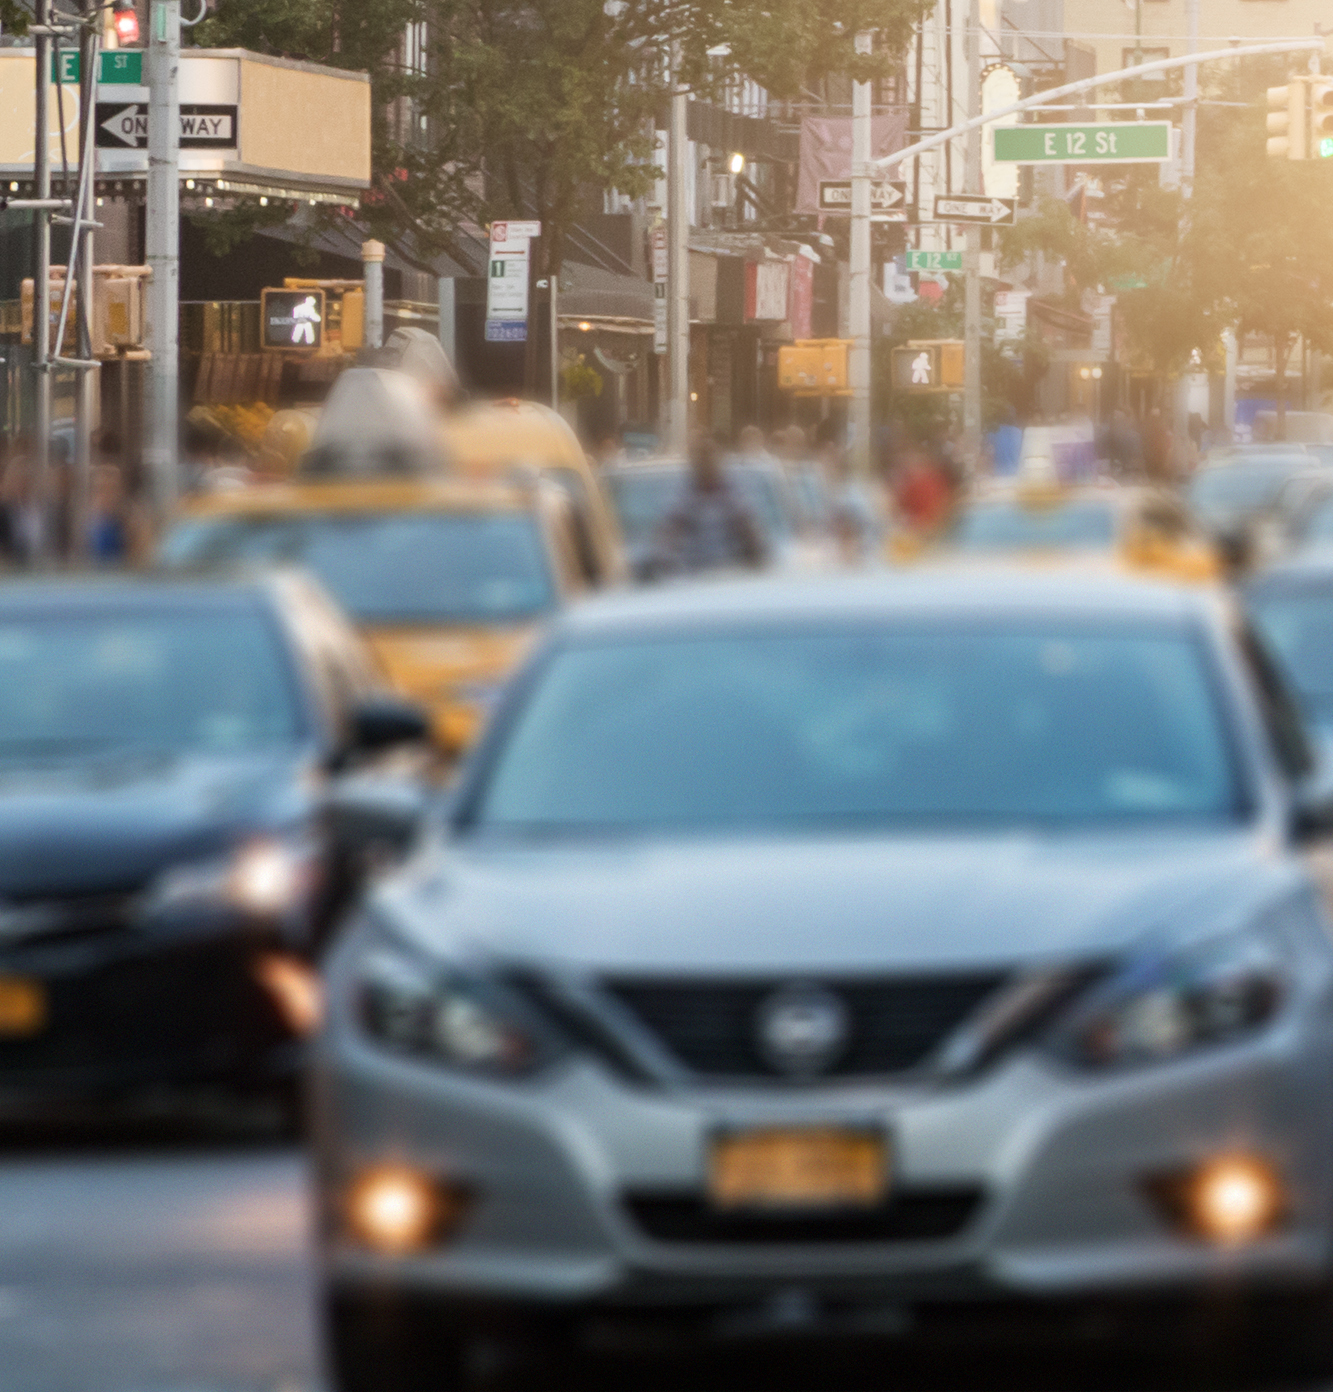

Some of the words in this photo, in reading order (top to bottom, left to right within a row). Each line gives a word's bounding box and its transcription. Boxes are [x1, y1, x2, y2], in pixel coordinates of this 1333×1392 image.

[61, 54, 76, 81] E
[114, 56, 128, 69] ST
[121, 117, 149, 135] ON
[180, 118, 222, 135] WAY
[1044, 132, 1057, 156] E
[1066, 131, 1086, 155] 12
[1095, 131, 1117, 154] St
[912, 252, 920, 268] E
[926, 252, 942, 268] 12
